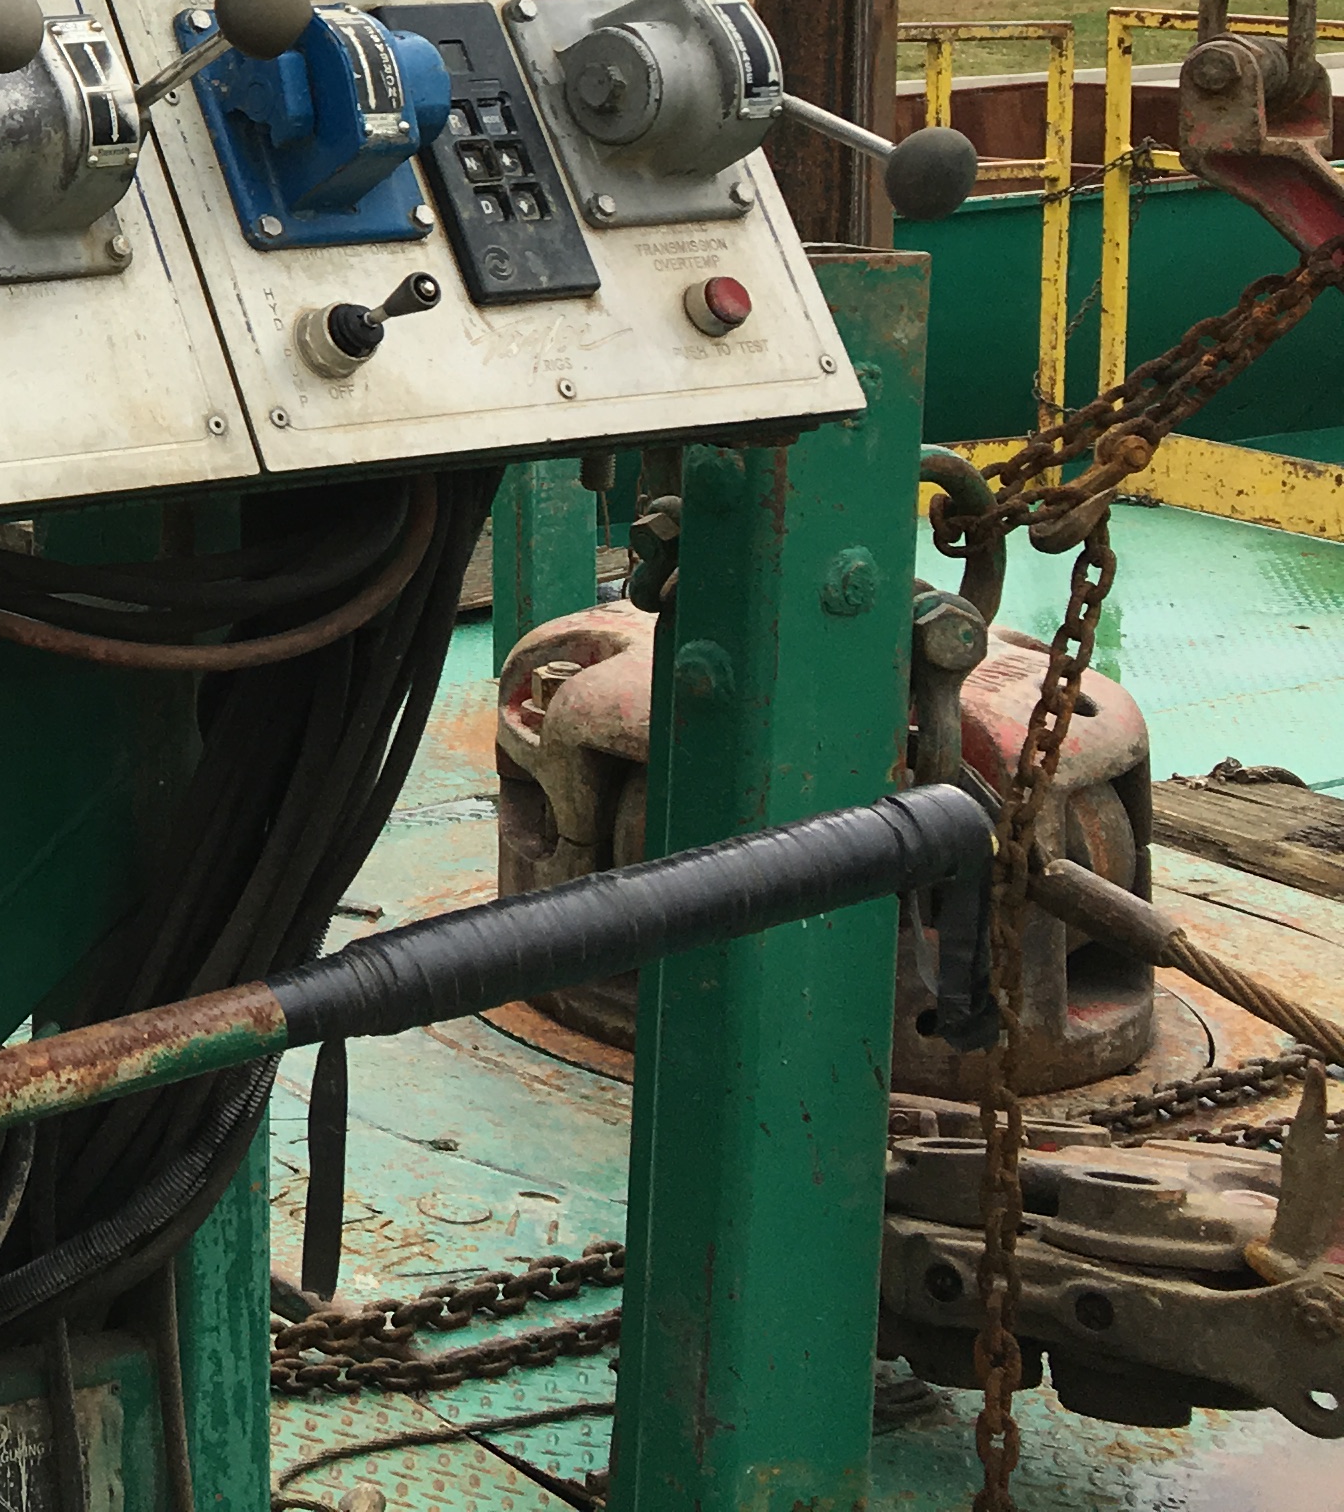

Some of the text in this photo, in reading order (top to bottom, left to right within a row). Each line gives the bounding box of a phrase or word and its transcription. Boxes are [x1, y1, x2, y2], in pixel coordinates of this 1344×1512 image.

[464, 157, 479, 171] N
[481, 200, 493, 214] D
[634, 238, 728, 256] TRANSMISSION
[654, 255, 720, 271] OVERTEMP
[263, 288, 284, 331] HYD
[712, 342, 731, 356] TO
[738, 339, 770, 354] TEST
[543, 357, 573, 372] RIGS
[329, 385, 355, 400] OFF
